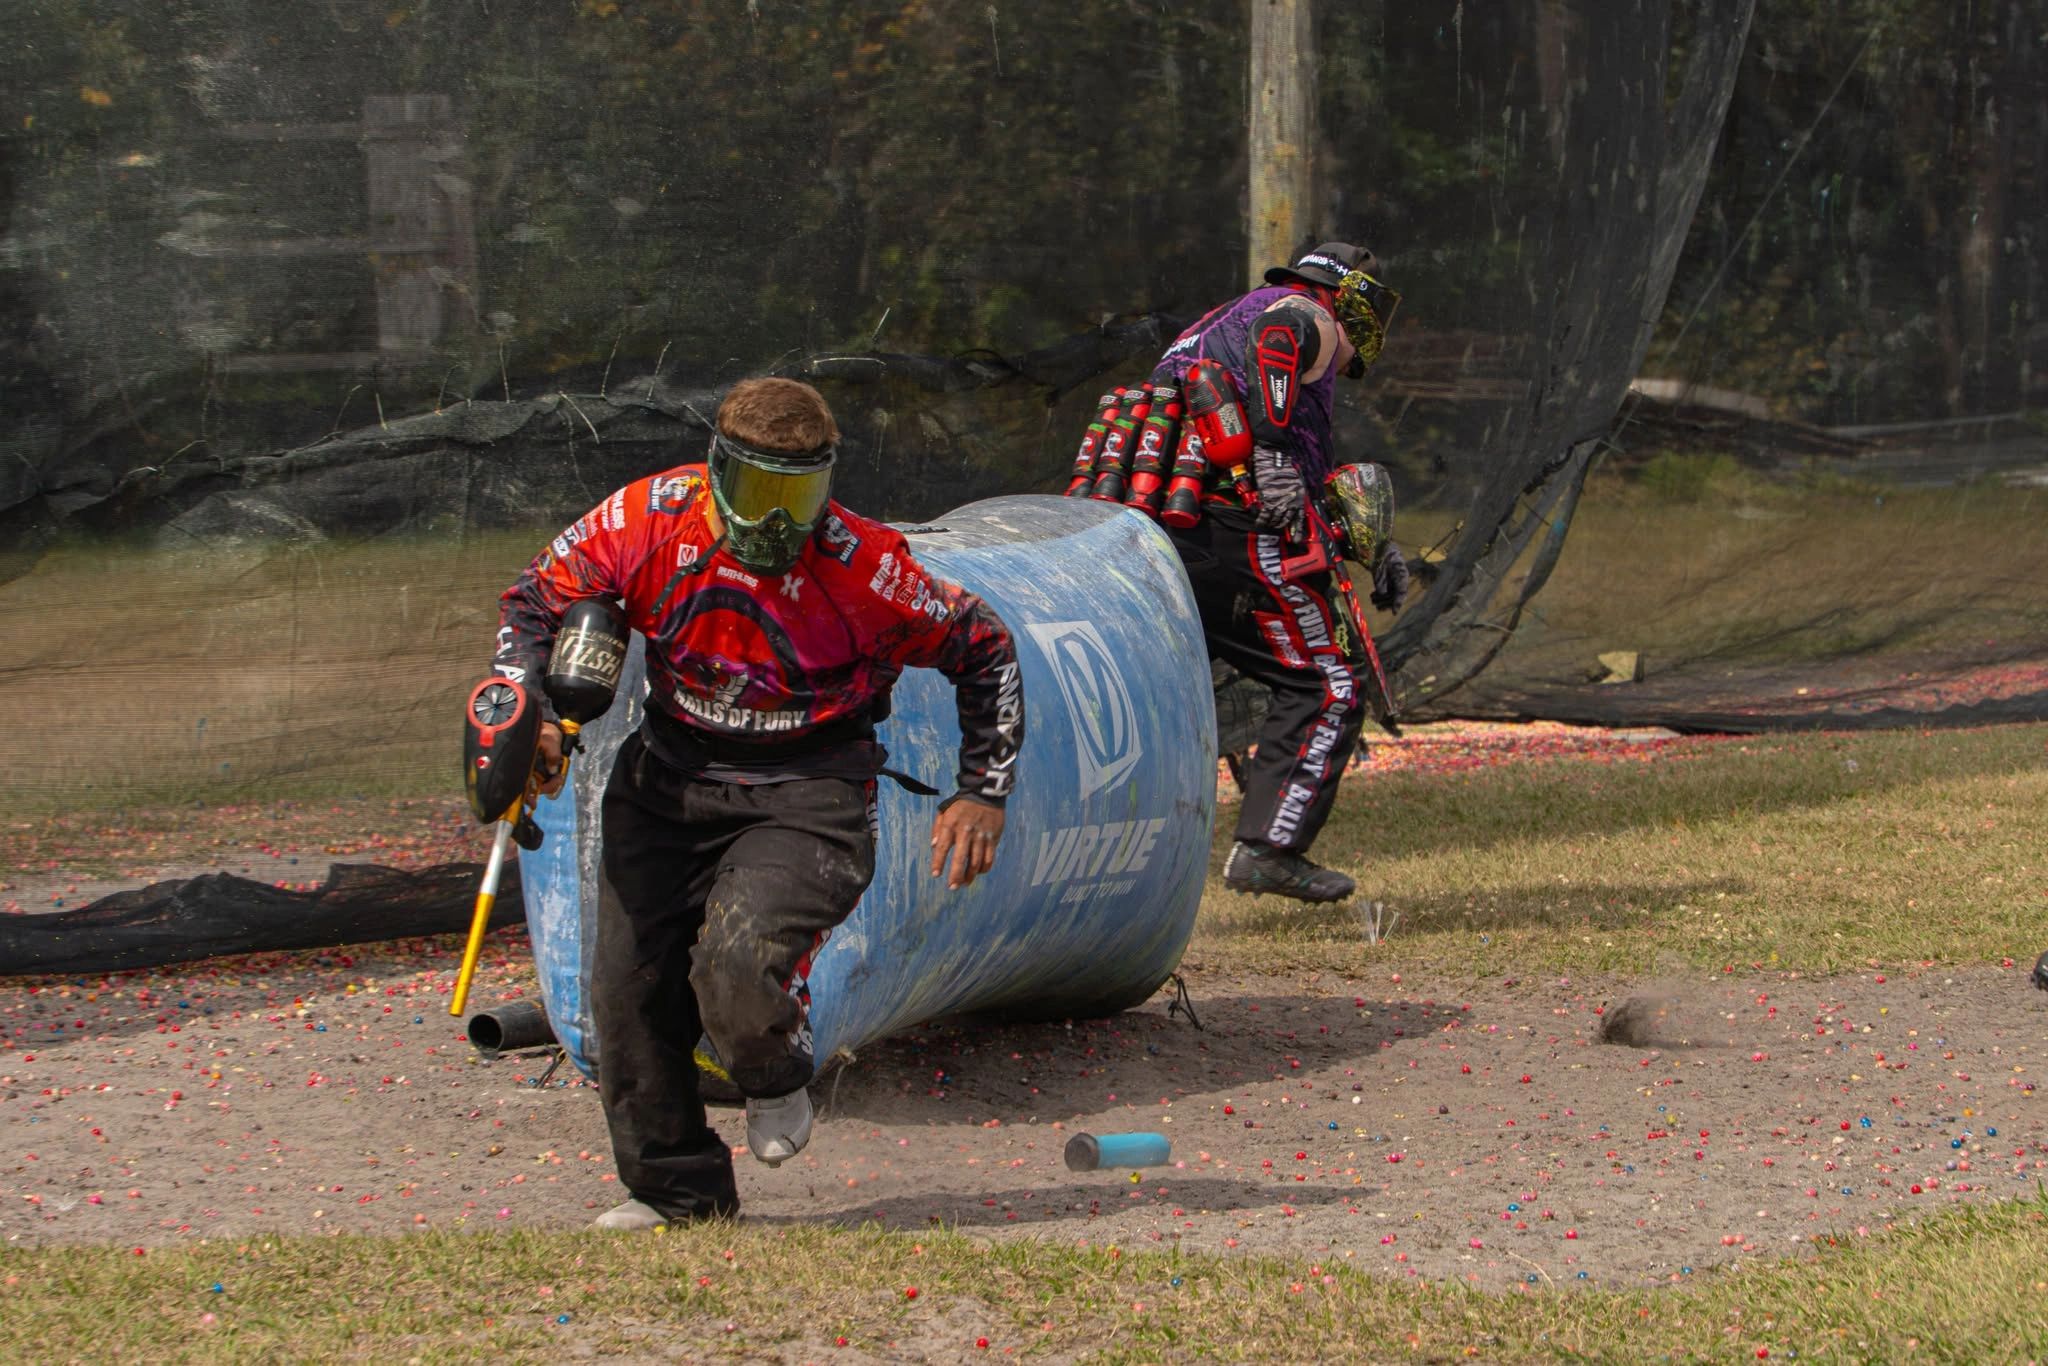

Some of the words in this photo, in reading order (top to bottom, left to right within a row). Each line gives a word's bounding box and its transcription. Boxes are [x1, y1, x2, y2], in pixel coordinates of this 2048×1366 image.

[1293, 603, 1331, 649] FURY
[727, 708, 751, 730] OF
[753, 710, 807, 732] FURY
[1301, 724, 1339, 779] FURY
[1267, 783, 1313, 846] BALLS
[1031, 817, 1167, 887] VIRTUE
